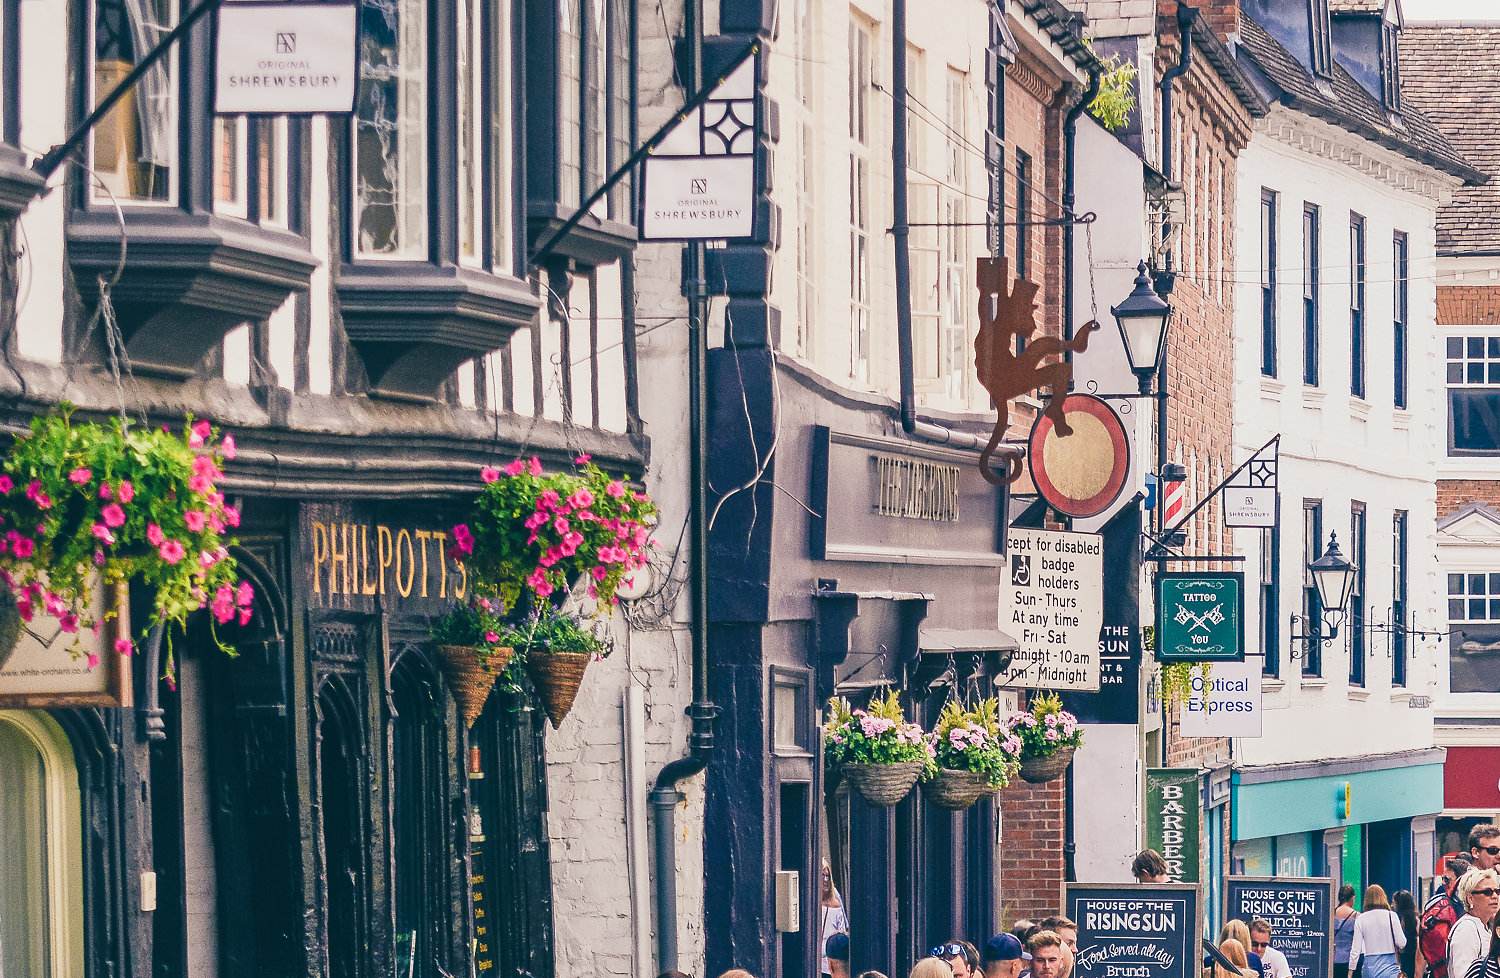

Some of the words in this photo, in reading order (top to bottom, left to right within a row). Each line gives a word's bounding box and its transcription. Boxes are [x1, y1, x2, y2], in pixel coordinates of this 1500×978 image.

[258, 61, 311, 70] ORIGINAL
[230, 75, 341, 88] SHREWSBURY
[677, 199, 719, 207] ORIGINAL
[655, 210, 742, 220] SHREWSBURY
[1007, 537, 1031, 554] cept
[1036, 537, 1051, 552] for
[1054, 541, 1101, 556] disabled
[1041, 556, 1075, 574] badge
[1038, 574, 1080, 591] holders
[1015, 590, 1036, 606] Sun
[1045, 593, 1077, 608] Thurs
[1182, 593, 1217, 602] TATTOO
[1012, 609, 1026, 625] At
[1029, 615, 1049, 628] any
[1054, 612, 1079, 627] time
[1047, 630, 1067, 645] Sat
[1104, 626, 1129, 636] THE
[1190, 634, 1209, 644] YOU
[1098, 640, 1129, 653] SUN
[1038, 666, 1088, 684] Midnight
[1102, 675, 1123, 684] BAR
[1188, 698, 1253, 715] Express
[1241, 890, 1275, 900] HOUSE
[1278, 891, 1294, 900] OF
[1295, 892, 1316, 901] THE
[1086, 901, 1127, 911] HOUSE
[1128, 902, 1144, 911] OF
[1146, 903, 1174, 911] THE
[1241, 900, 1284, 914] RISING
[1286, 902, 1315, 915] SUN
[1086, 912, 1141, 931] RISING
[1142, 913, 1176, 932] SUN
[1077, 944, 1110, 970] Food
[1109, 943, 1140, 958] Served
[1140, 943, 1157, 957] all
[1155, 948, 1175, 970] day
[1106, 965, 1151, 978] Brunch
